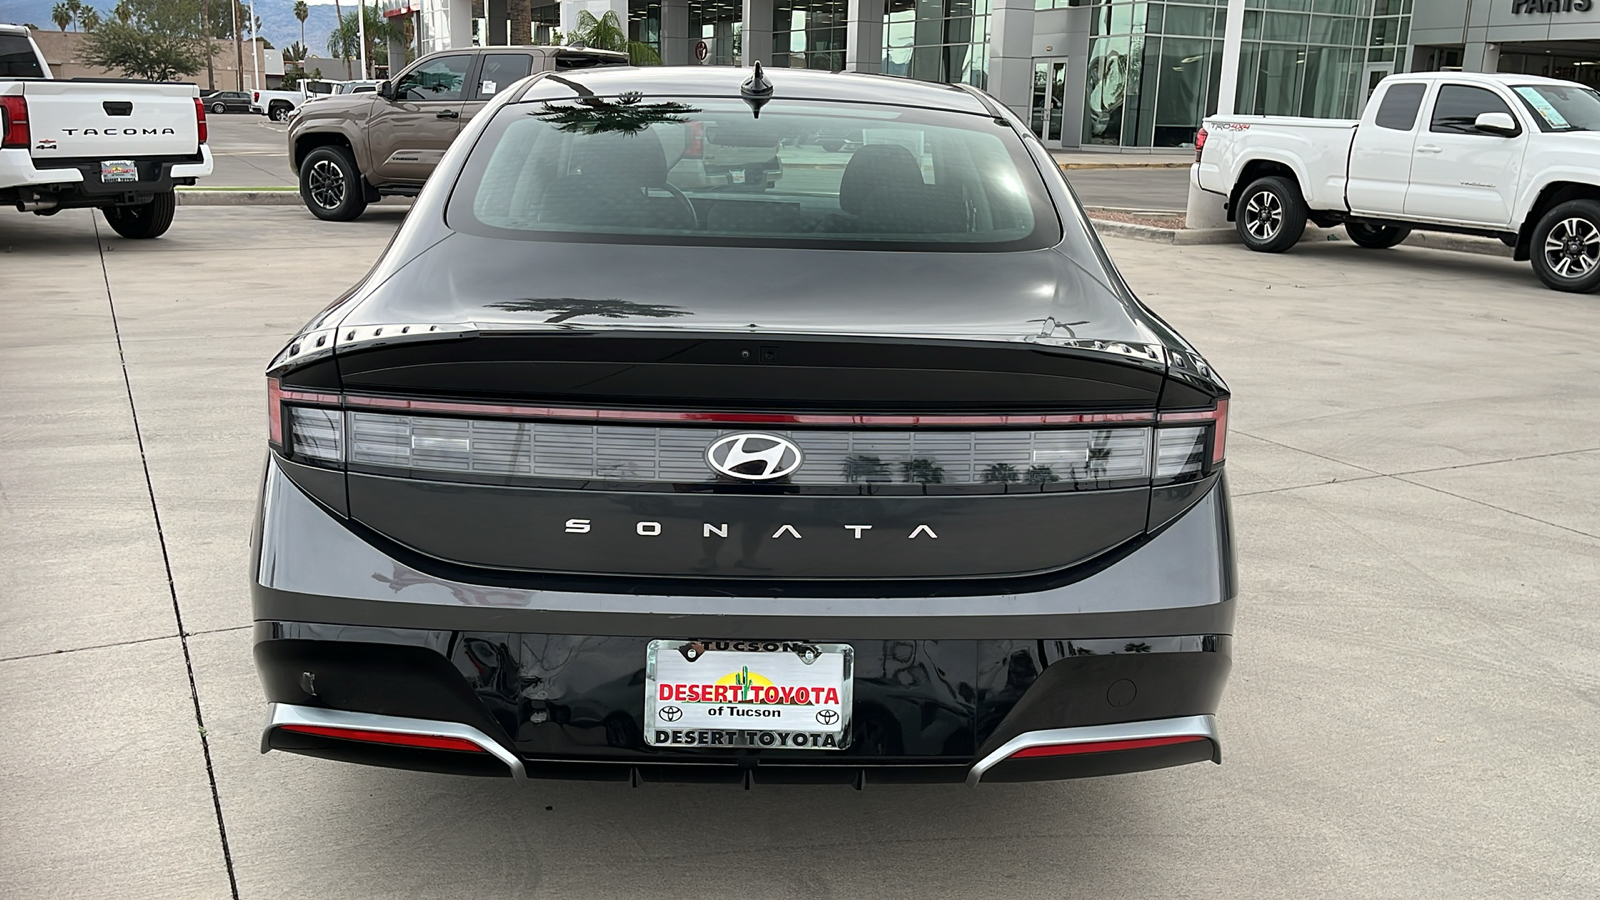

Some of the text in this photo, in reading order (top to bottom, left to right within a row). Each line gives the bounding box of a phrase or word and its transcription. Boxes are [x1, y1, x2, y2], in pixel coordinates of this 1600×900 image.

[565, 518, 938, 539] SONATA
[701, 641, 799, 652] TUCSON
[659, 683, 840, 705] DESERT TOYOTA
[707, 706, 782, 718] of Tucson
[655, 730, 838, 748] DESERT TOYOTA
